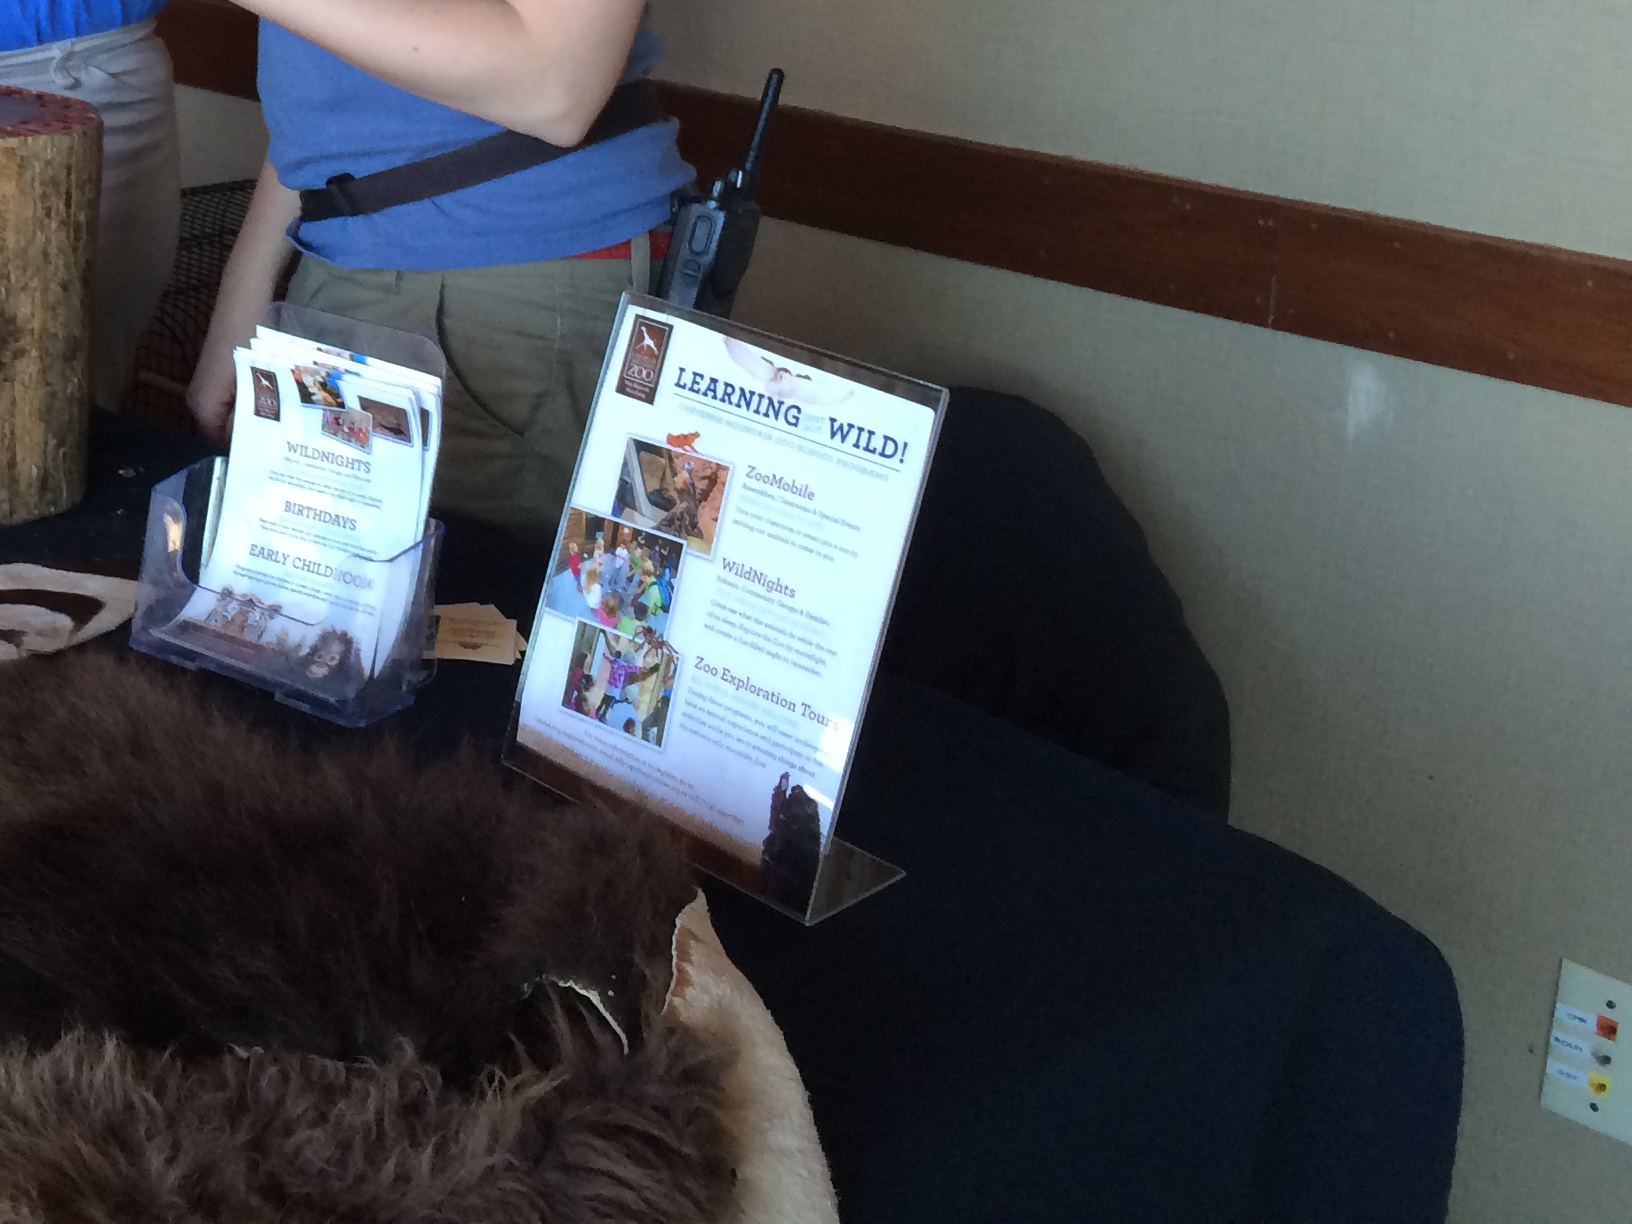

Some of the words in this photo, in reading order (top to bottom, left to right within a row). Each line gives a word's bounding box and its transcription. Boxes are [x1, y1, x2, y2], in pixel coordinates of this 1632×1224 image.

[674, 366, 803, 428] LEARNING
[828, 416, 909, 464] WILD!
[286, 440, 372, 474] WILDNIGHTS
[745, 464, 815, 501] ZooMobile
[283, 500, 358, 531] BIRTHDAYS
[248, 543, 290, 566] EARLY
[722, 557, 796, 598] WildNights
[694, 655, 718, 677] Zoo
[720, 667, 797, 714] Exploration
[800, 701, 839, 731] Tours
